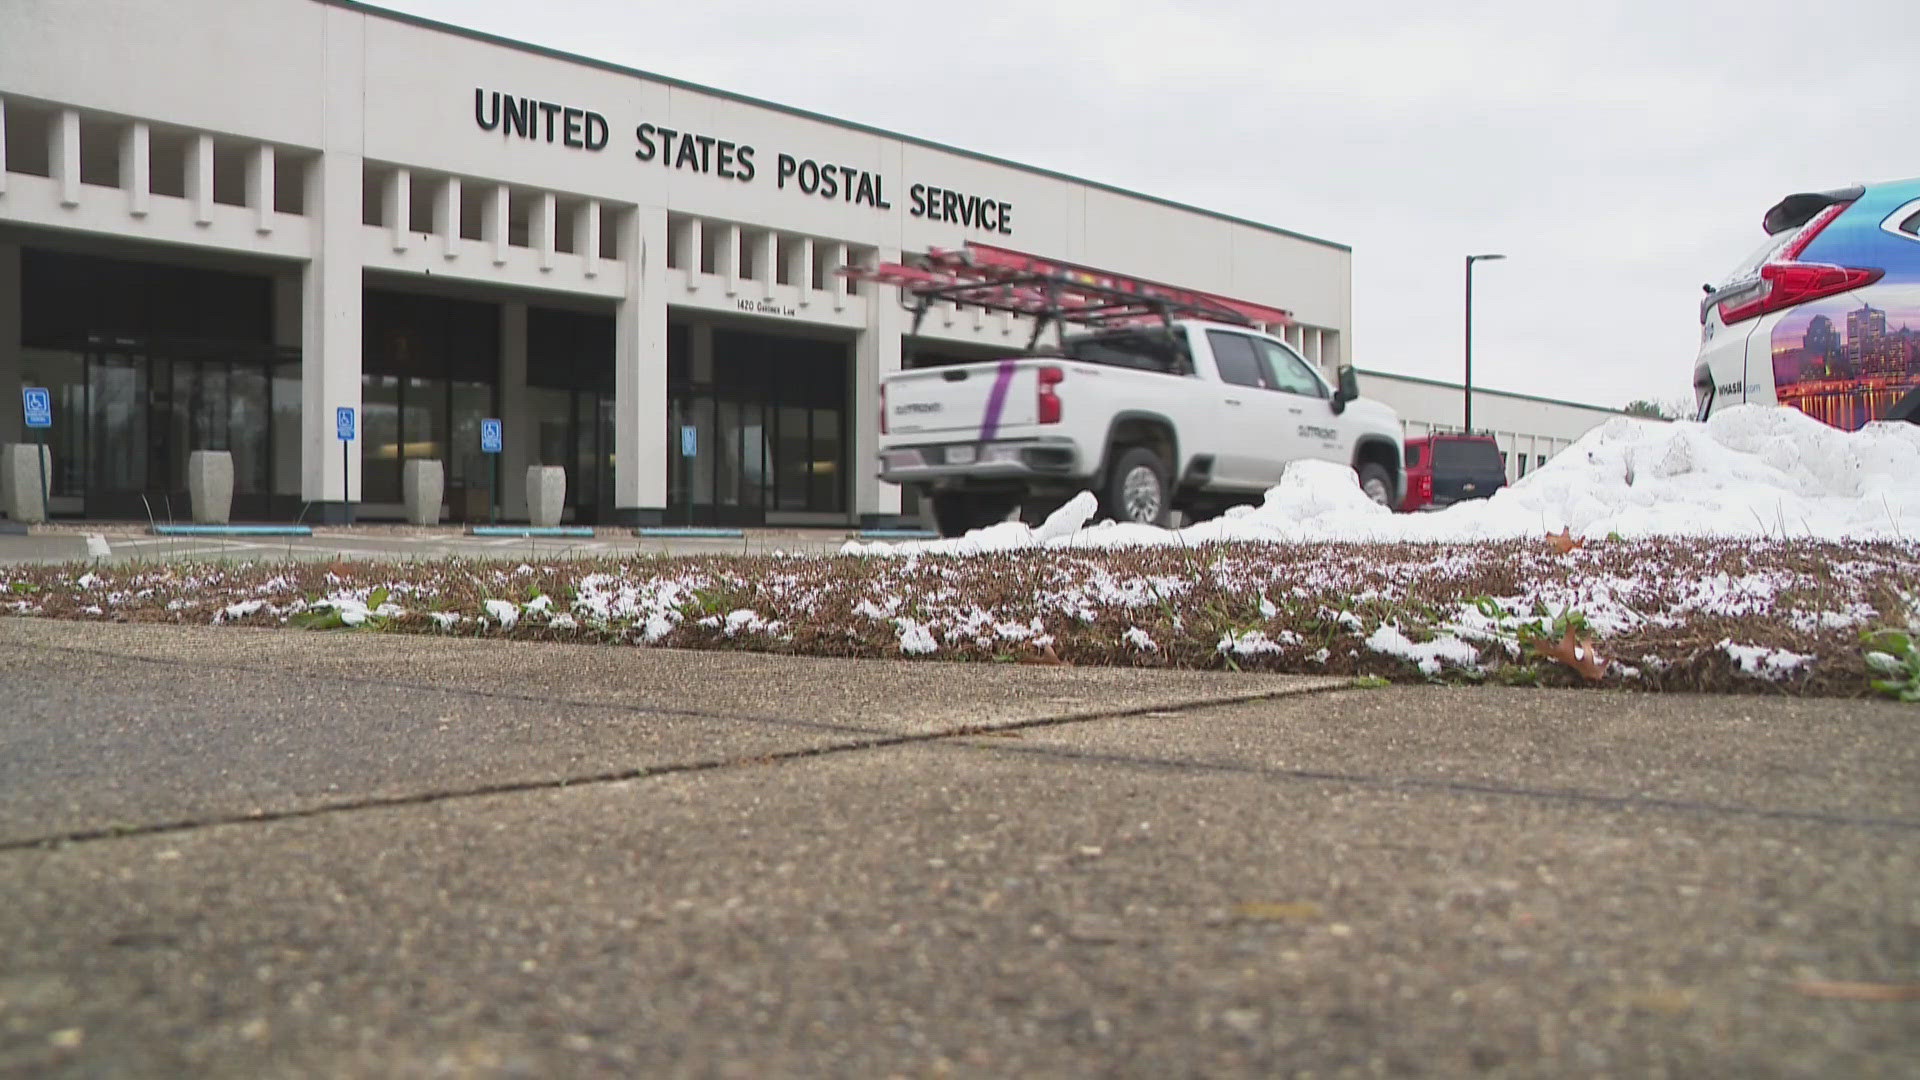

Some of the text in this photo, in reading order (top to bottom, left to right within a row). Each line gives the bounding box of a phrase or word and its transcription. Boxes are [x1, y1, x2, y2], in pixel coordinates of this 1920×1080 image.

[475, 87, 1013, 235] UNITED STATES POSTAL SERVICE
[737, 299, 754, 311] 1420
